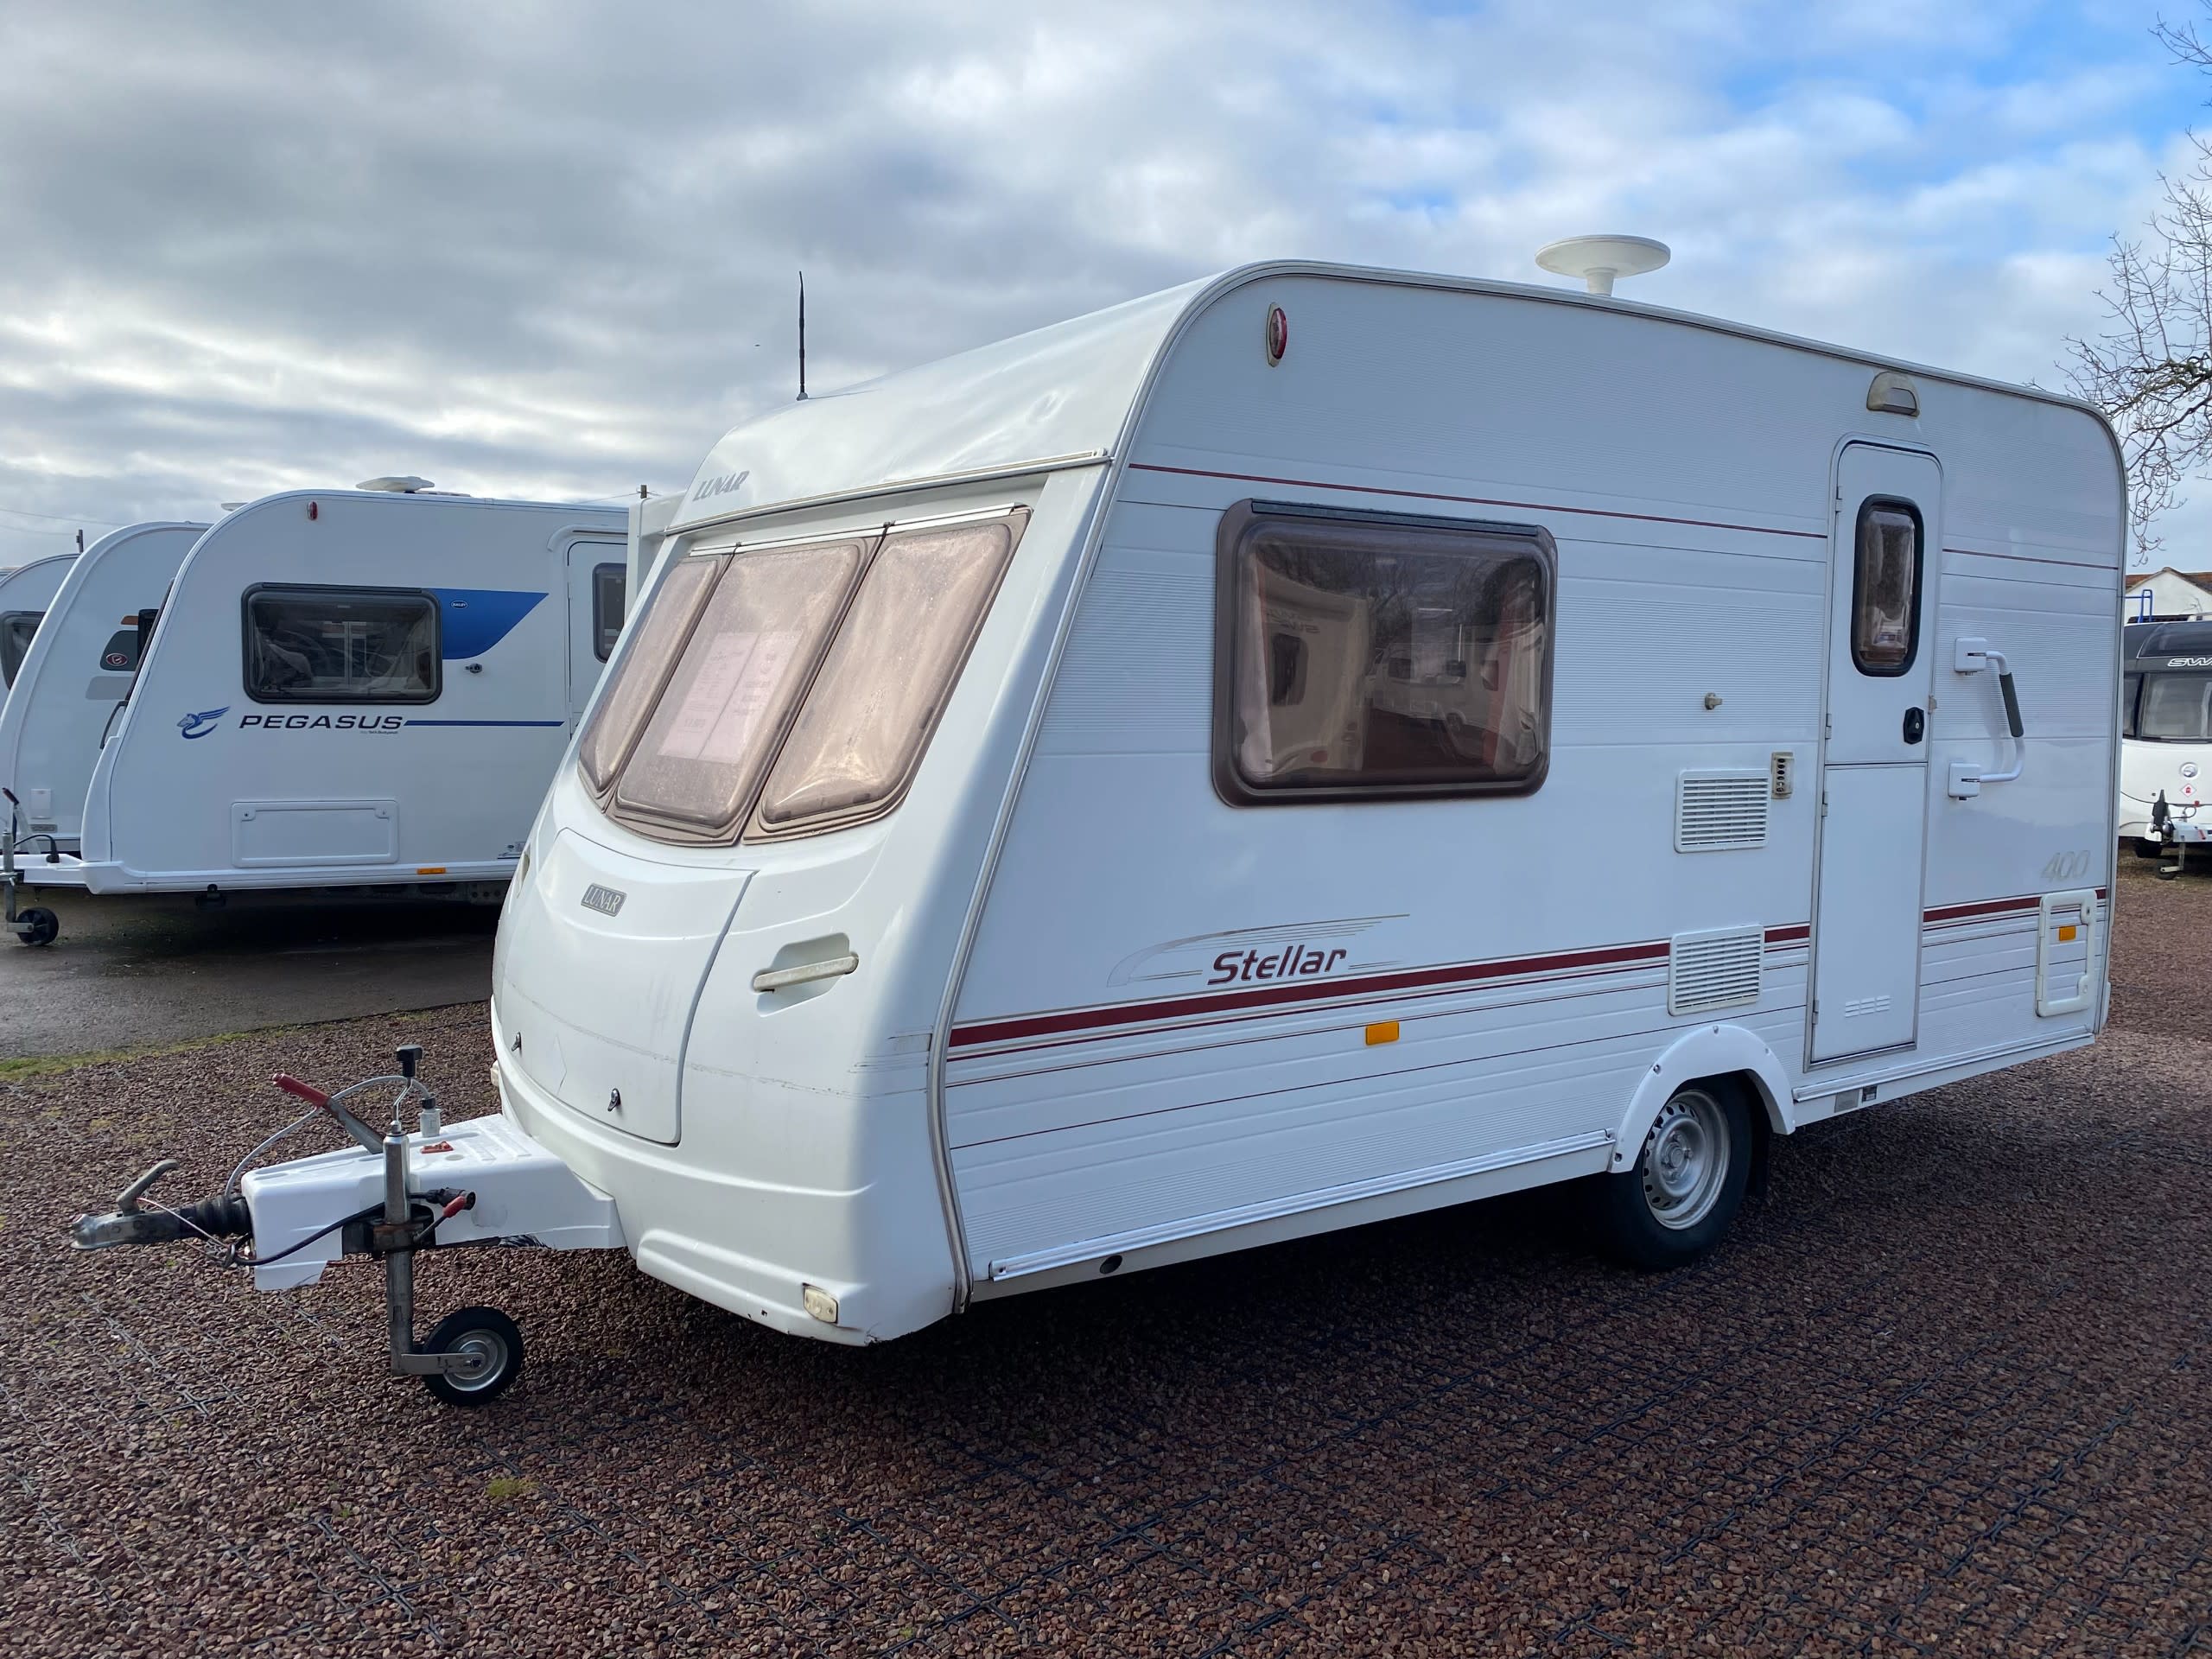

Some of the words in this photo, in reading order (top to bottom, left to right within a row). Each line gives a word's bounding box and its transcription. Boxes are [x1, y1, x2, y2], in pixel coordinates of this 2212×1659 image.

[692, 470, 750, 502] LUNAR
[238, 715, 403, 729] PEGASUS
[2040, 849, 2090, 883] 400
[584, 886, 621, 912] LUNAR
[1207, 944, 1346, 986] Stellar
